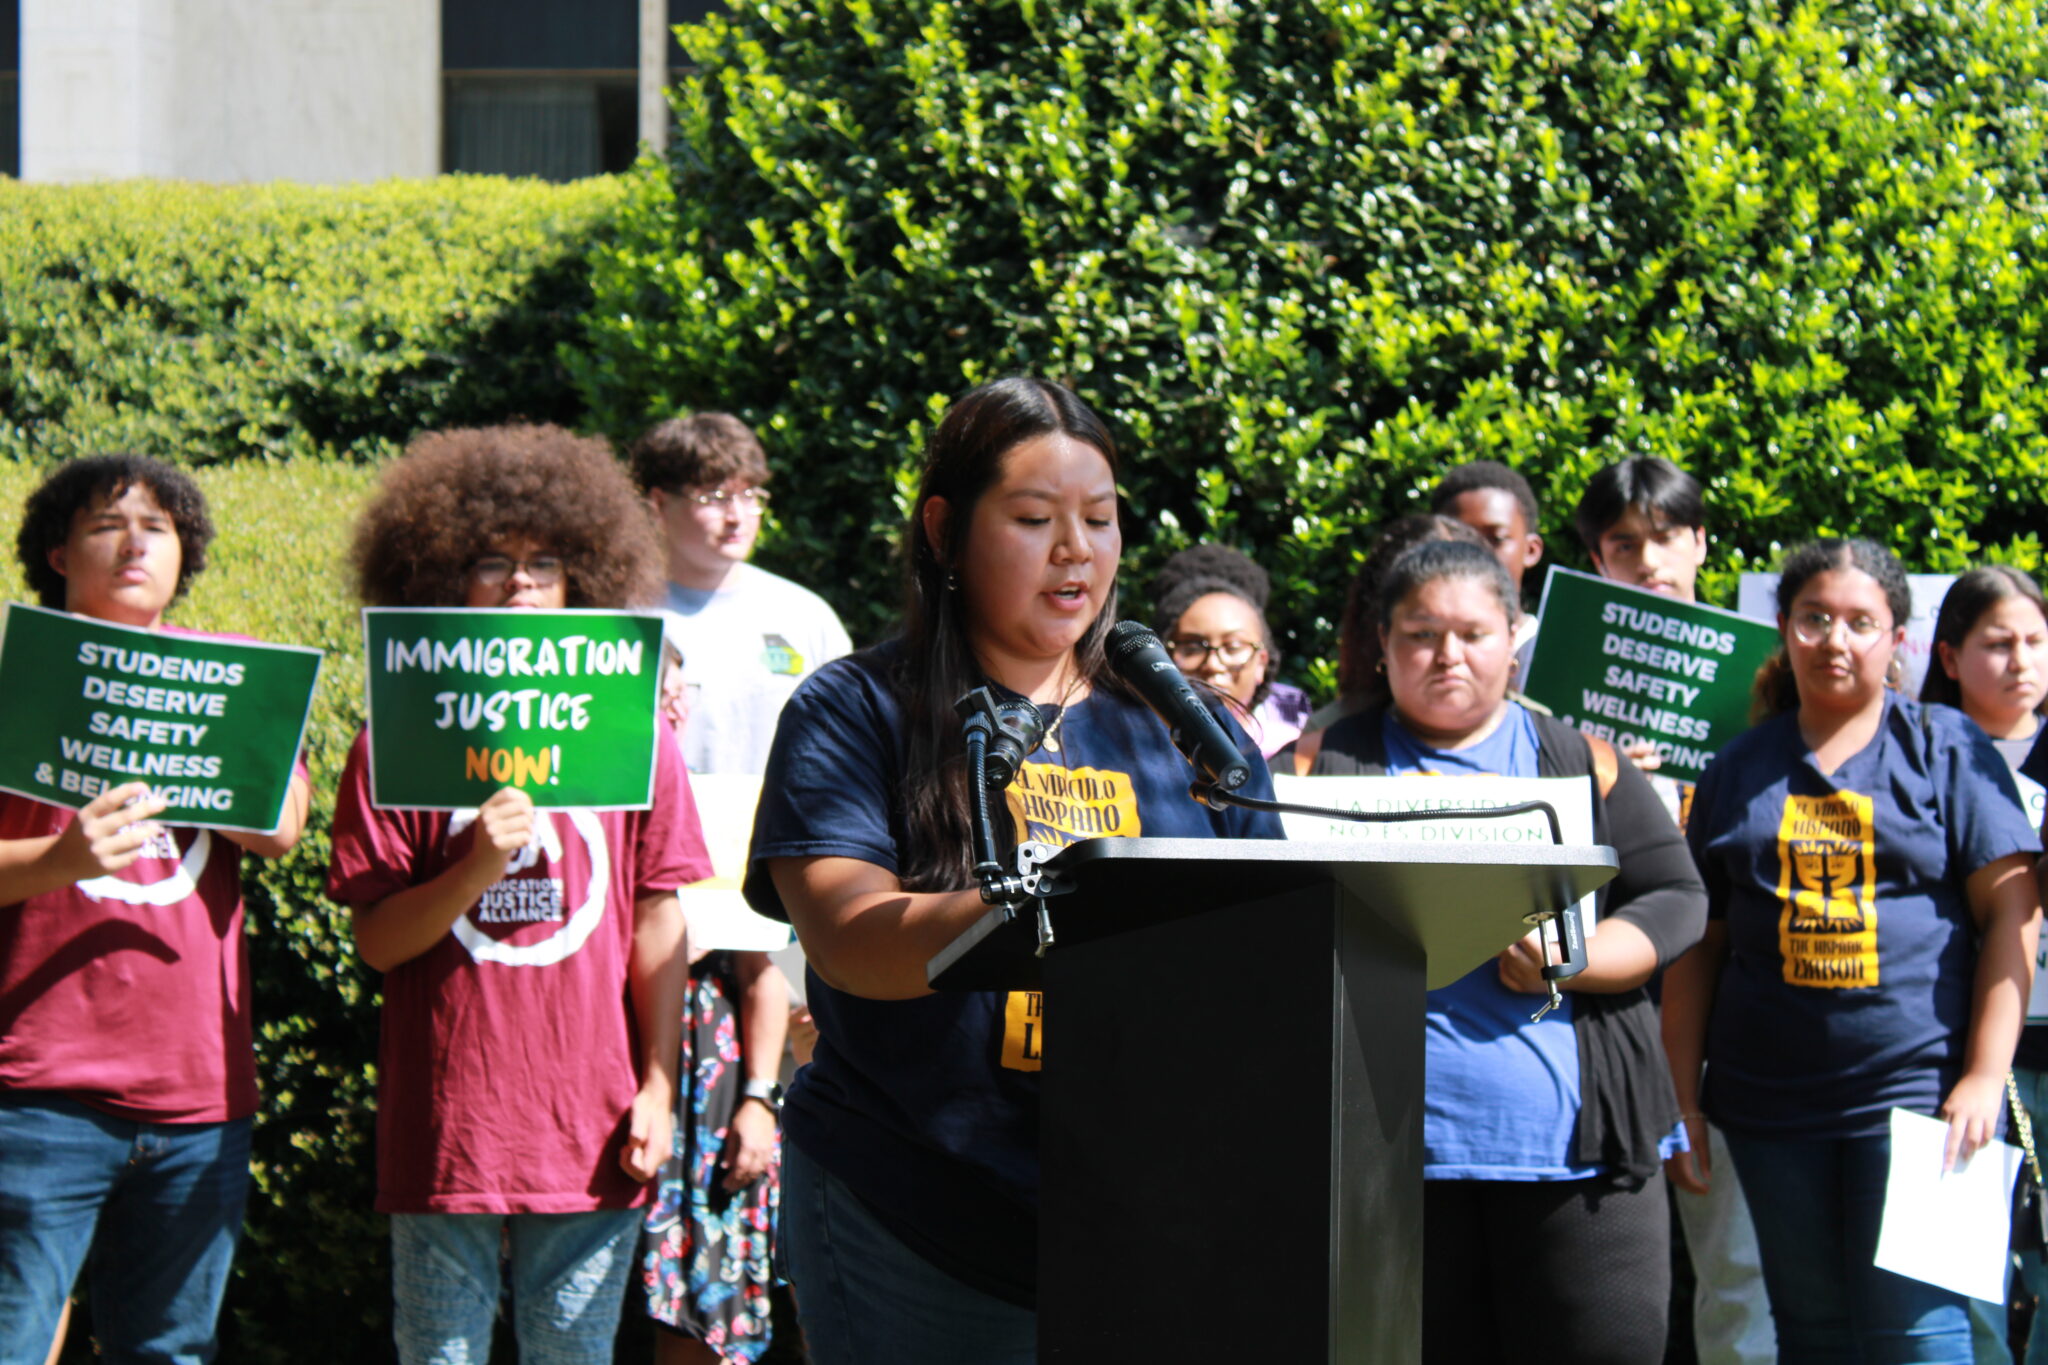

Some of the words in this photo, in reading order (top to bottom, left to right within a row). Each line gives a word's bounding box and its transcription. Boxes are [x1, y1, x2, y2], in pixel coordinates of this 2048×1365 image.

[1602, 602, 1736, 655] STUDENDS
[77, 641, 246, 686] STUDENDS
[385, 635, 644, 677] IMMIGRATION
[1603, 632, 1719, 682] DESERVE
[82, 676, 227, 717] DESERVE
[1604, 664, 1700, 708] SAFETY
[89, 711, 208, 746] SAFETY
[434, 688, 593, 732] JUSTICE
[1582, 688, 1711, 741] WELLNESS
[34, 762, 54, 786] &
[60, 736, 222, 778] WELLNESS
[465, 744, 561, 788] NOW!
[1022, 791, 1121, 833] HISPANO
[1376, 799, 1532, 814] DIVERSID
[1330, 825, 1370, 839] NO
[1421, 826, 1543, 842] DIVISION
[479, 891, 564, 910] JUSTICE
[487, 878, 564, 893] UCATION
[478, 908, 564, 923] ALLIANCE
